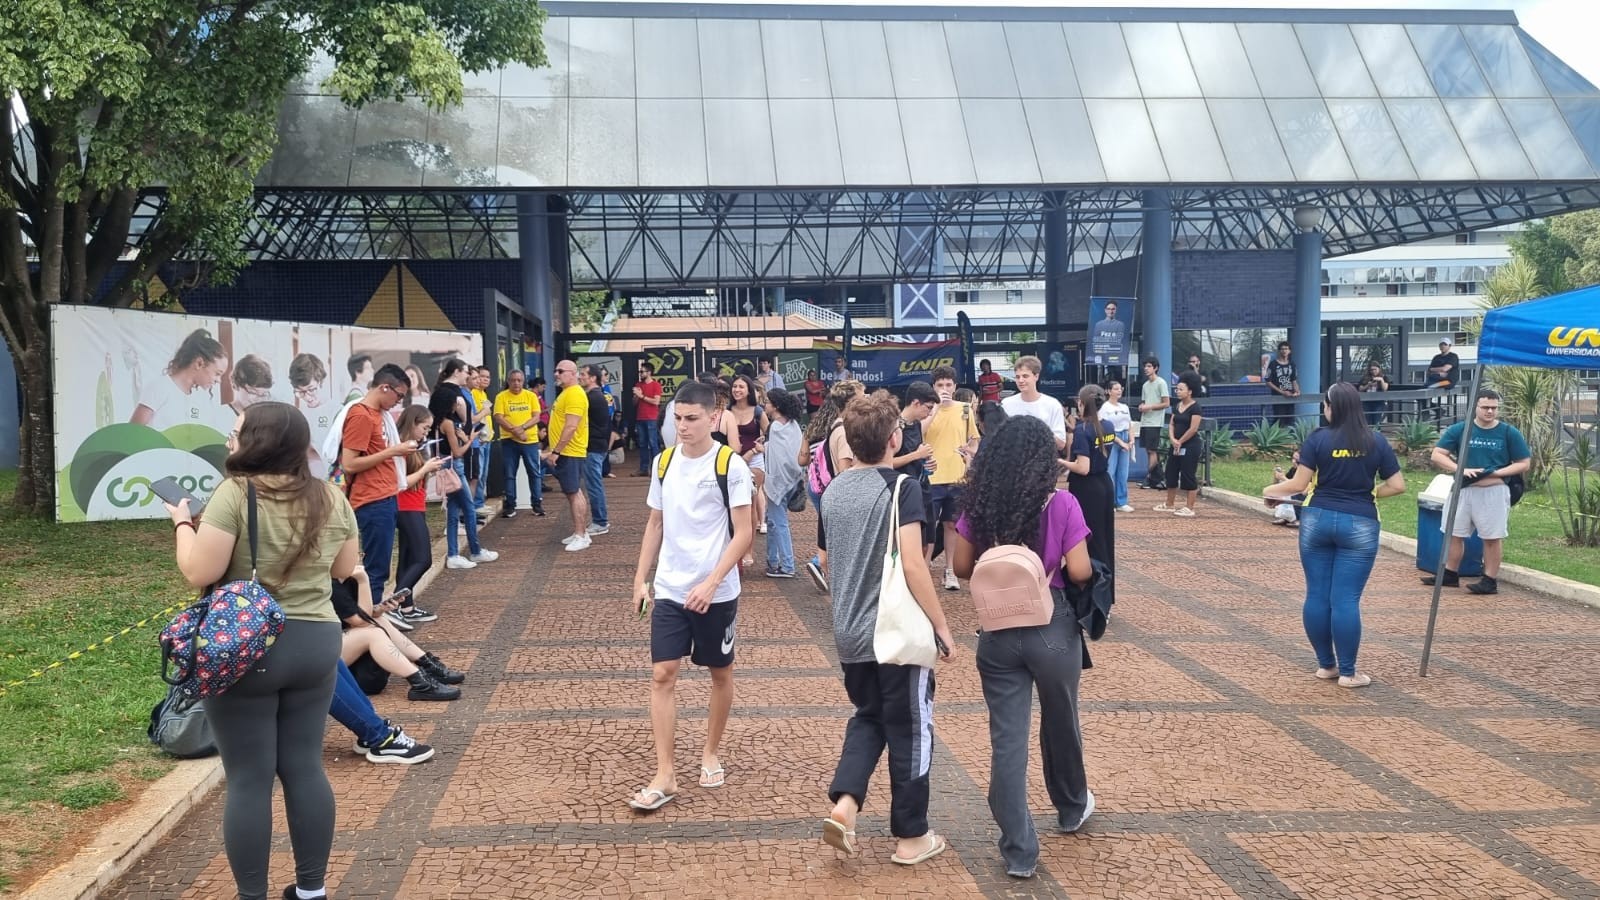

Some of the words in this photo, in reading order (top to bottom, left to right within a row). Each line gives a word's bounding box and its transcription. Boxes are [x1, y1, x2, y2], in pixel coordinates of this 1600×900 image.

[1548, 326, 1600, 347] UN
[1546, 347, 1600, 357] UNIVERSIDAD
[786, 361, 807, 375] BOA
[656, 377, 675, 387] OA
